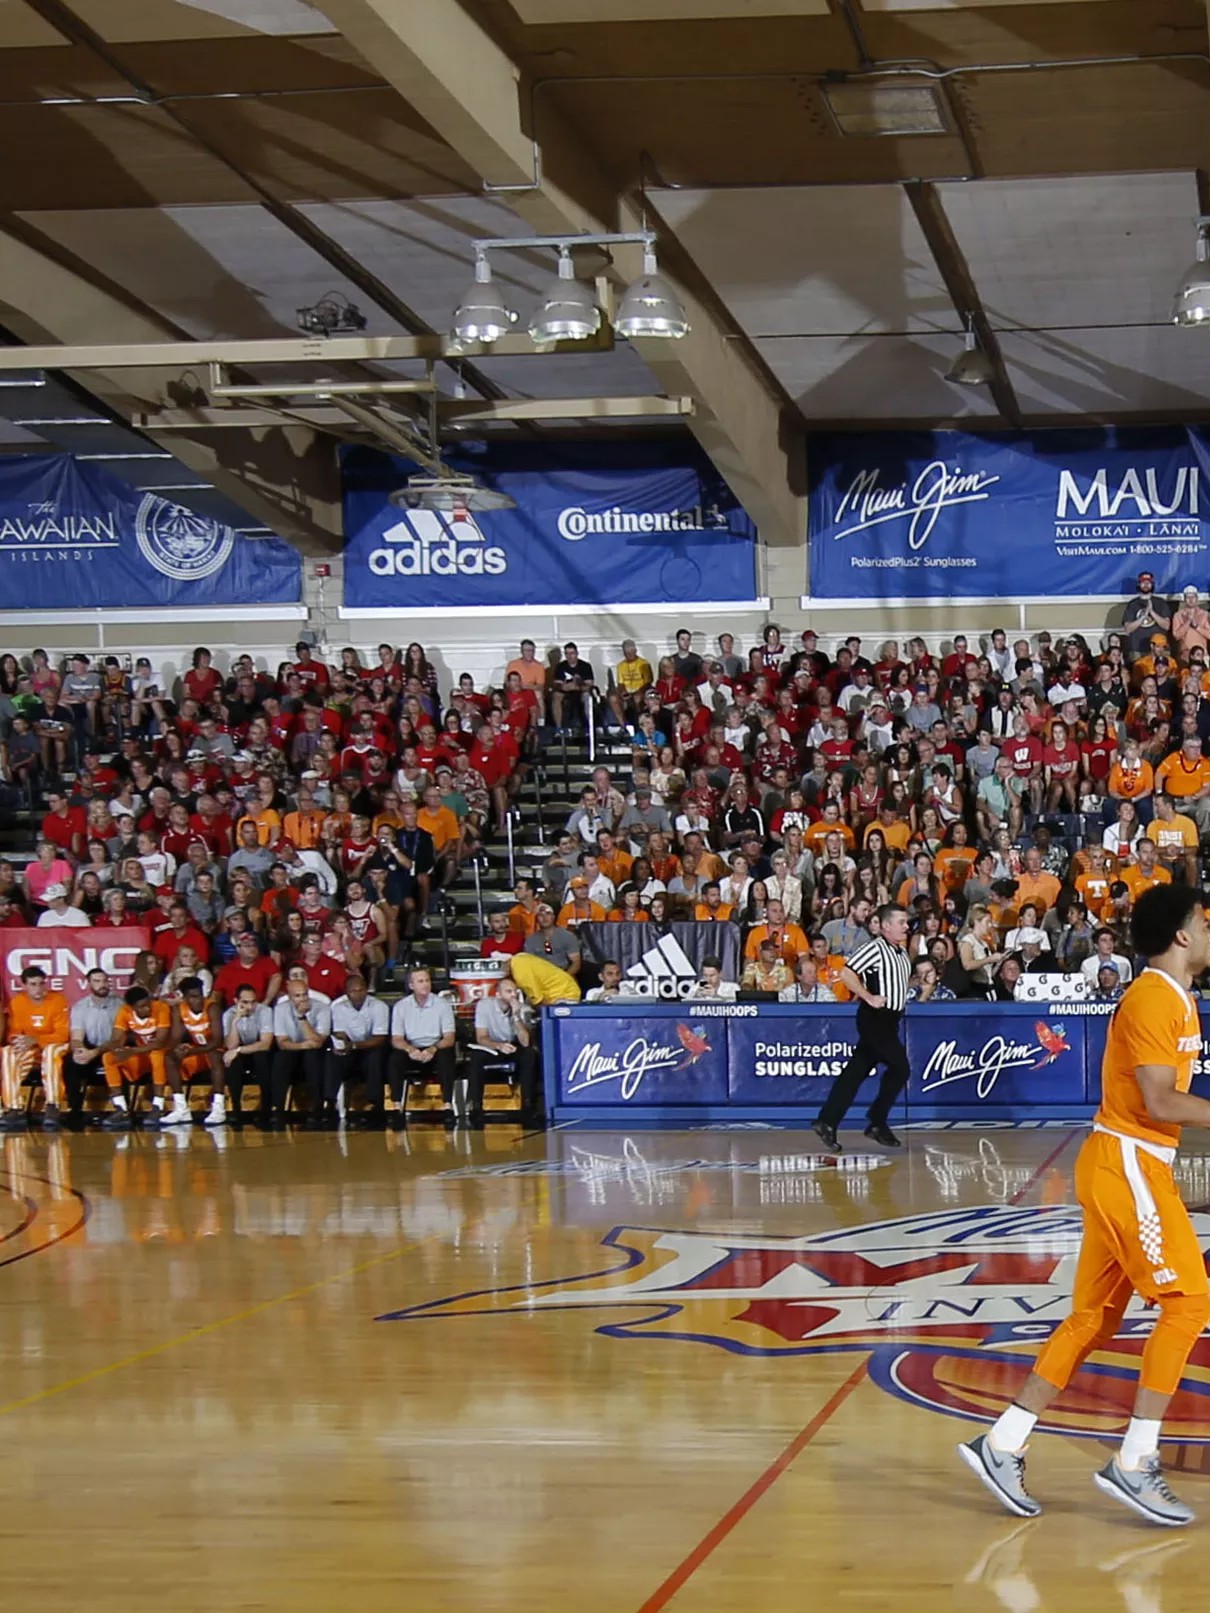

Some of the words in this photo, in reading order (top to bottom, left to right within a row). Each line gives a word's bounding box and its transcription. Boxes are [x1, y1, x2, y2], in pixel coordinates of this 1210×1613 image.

[834, 468, 906, 523] Maui
[908, 460, 1000, 550] Jim
[1057, 466, 1199, 518] MAUI
[0, 512, 114, 541] AWAIIAN
[557, 506, 704, 541] Continental
[12, 551, 94, 561] ISLANDS
[368, 540, 507, 576] adidas
[923, 557, 977, 569] Sunglasses
[6, 947, 142, 977] GNC
[11, 978, 64, 991] LE
[689, 1006, 758, 1017] #MAUIHOOPS
[568, 1042, 619, 1081] Maui
[621, 1037, 685, 1100] Jim
[755, 1061, 877, 1076] SUNGLAS
[922, 1040, 975, 1080] Maui
[978, 1035, 1043, 1098] Jim
